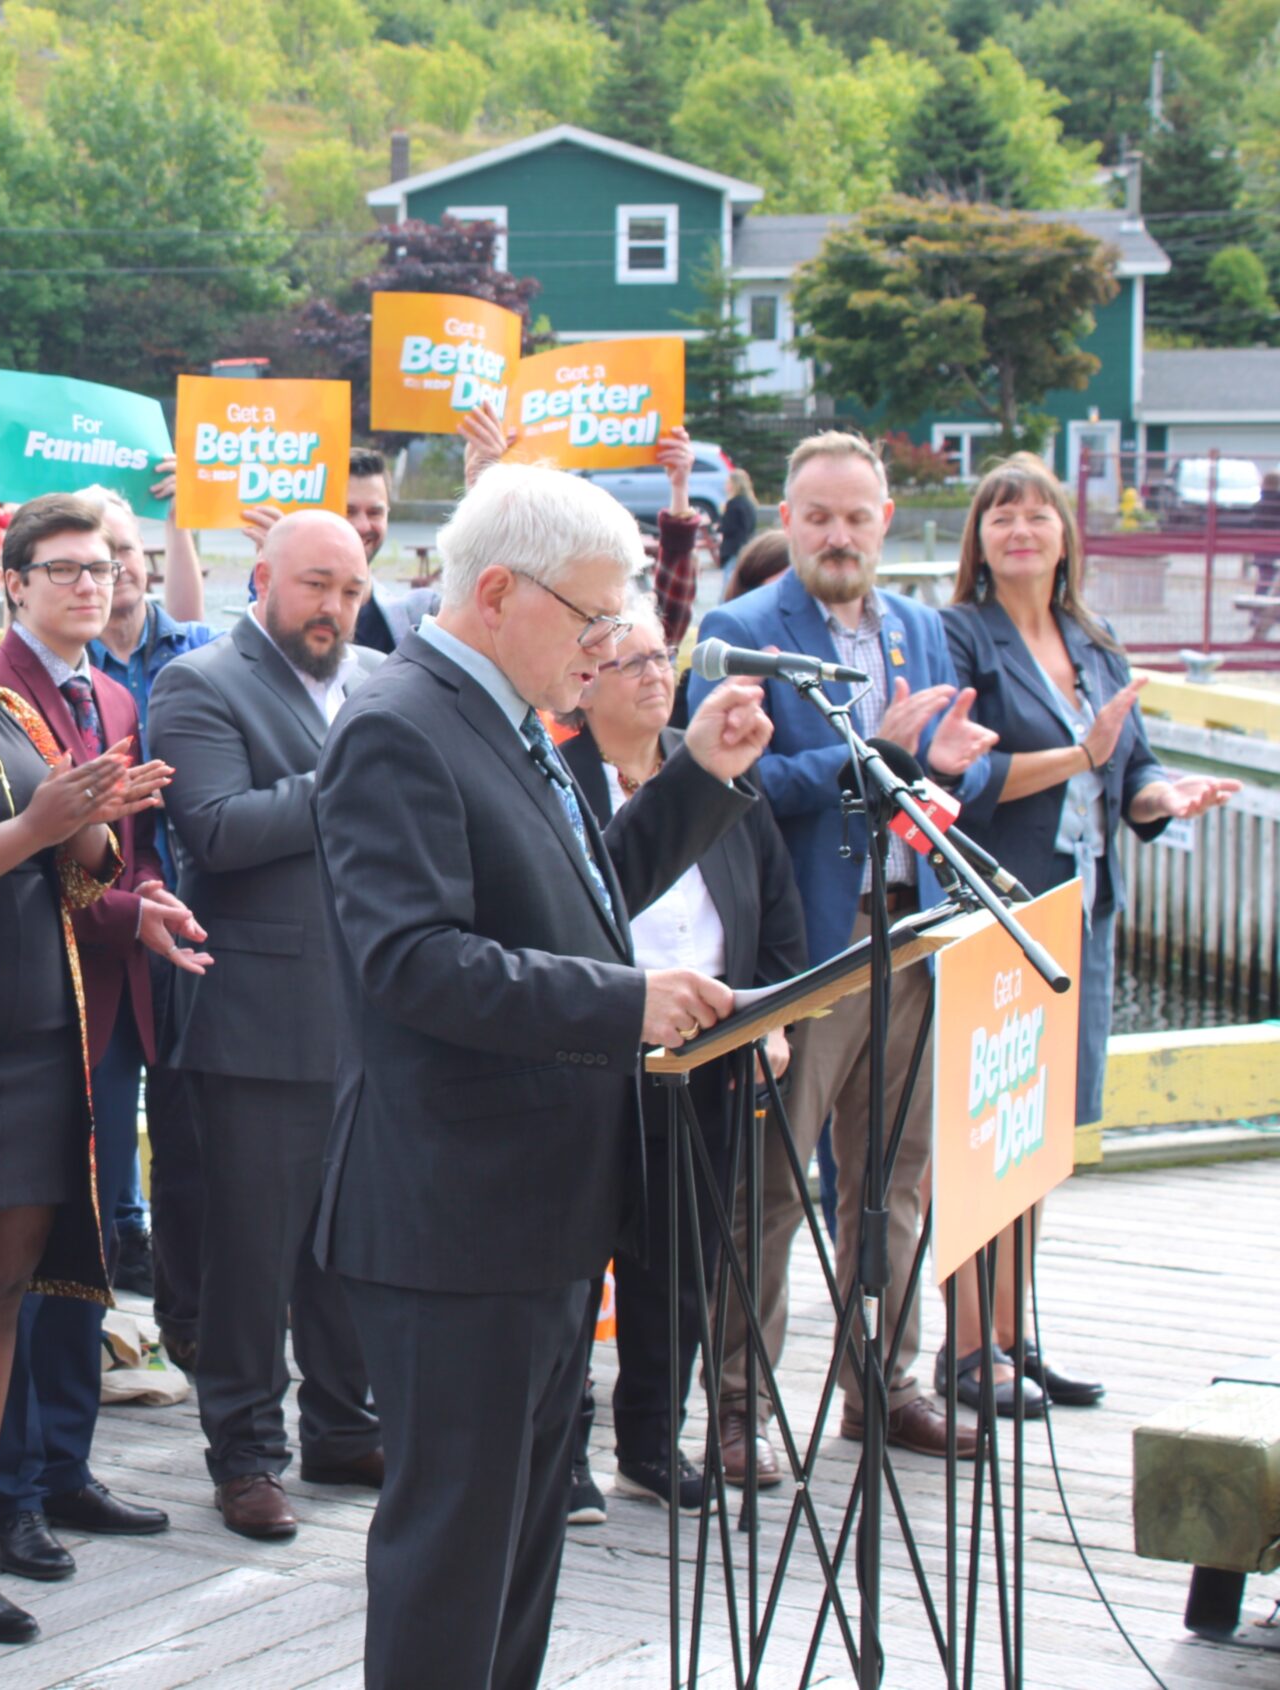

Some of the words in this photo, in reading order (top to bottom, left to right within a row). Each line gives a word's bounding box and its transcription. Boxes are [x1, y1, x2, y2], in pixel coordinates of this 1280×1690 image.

[444, 318, 474, 337] Get
[400, 336, 506, 384] Better
[555, 365, 590, 383] Get
[593, 365, 606, 379] a
[227, 403, 260, 423] Get
[263, 407, 276, 423] a
[521, 382, 652, 425] Better
[72, 414, 103, 434] For
[569, 410, 662, 447] Deal
[24, 430, 149, 470] Families
[195, 423, 320, 466] Better
[238, 463, 327, 503] Deal
[993, 970, 1013, 1011] Get
[1014, 967, 1022, 998] a
[969, 1004, 1045, 1119] Better
[993, 1063, 1046, 1181] Deal
